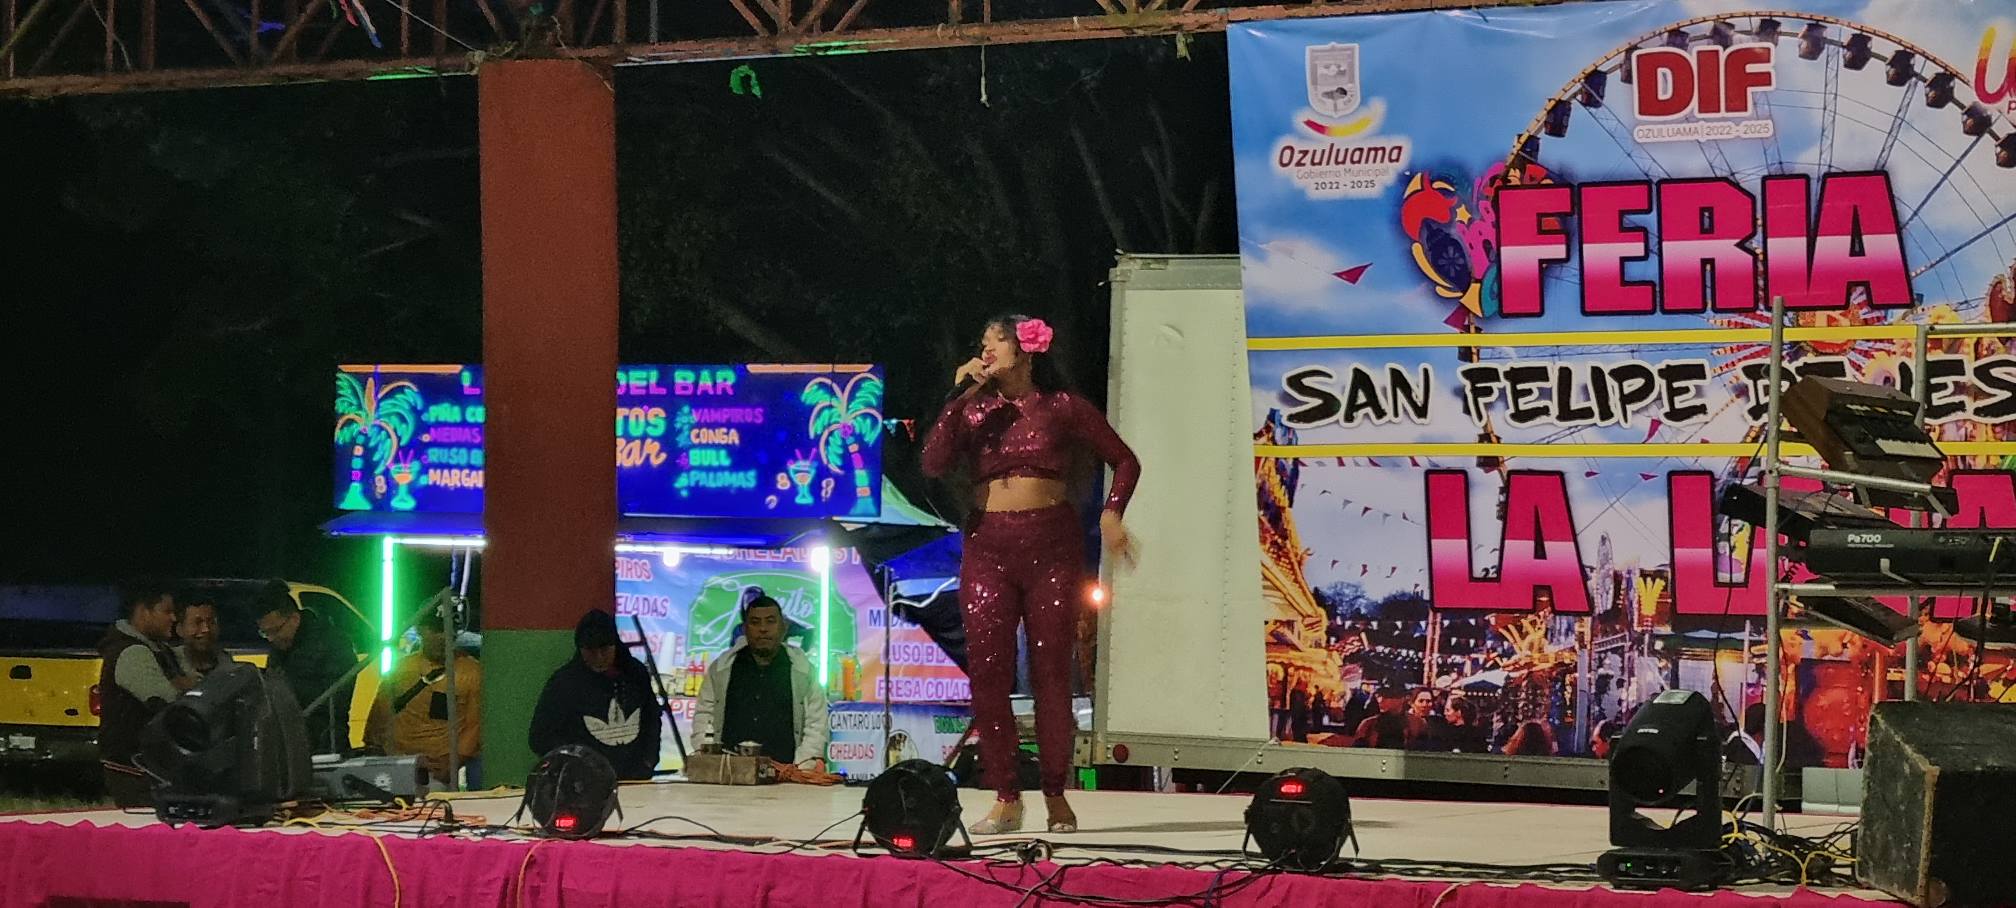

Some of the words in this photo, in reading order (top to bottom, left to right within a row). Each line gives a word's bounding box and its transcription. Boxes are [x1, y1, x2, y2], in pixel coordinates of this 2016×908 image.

[1636, 47, 1773, 117] DIF
[1637, 126, 1699, 138] OZULUAMA
[1278, 143, 1403, 168] Ozuluama
[1296, 168, 1342, 180] Gobierno
[1344, 166, 1388, 179] Municipal
[1314, 181, 1340, 190] 2022
[1351, 179, 1376, 188] 2025
[1498, 170, 1913, 318] FERIA
[674, 370, 735, 395] BAR
[1286, 367, 1433, 424] SAN
[1462, 362, 1708, 426] FELIPE
[692, 407, 764, 424] VAMPIROS
[690, 427, 740, 446] CONGA
[427, 447, 468, 467] RUSO
[688, 448, 732, 467] BULL
[688, 469, 758, 489] PALOMAS
[1425, 469, 1594, 615] LA
[1847, 534, 1882, 543] Pa700
[877, 679, 921, 698] FRESA
[829, 712, 868, 731] CANTARO
[829, 744, 875, 760] CHELADAS
